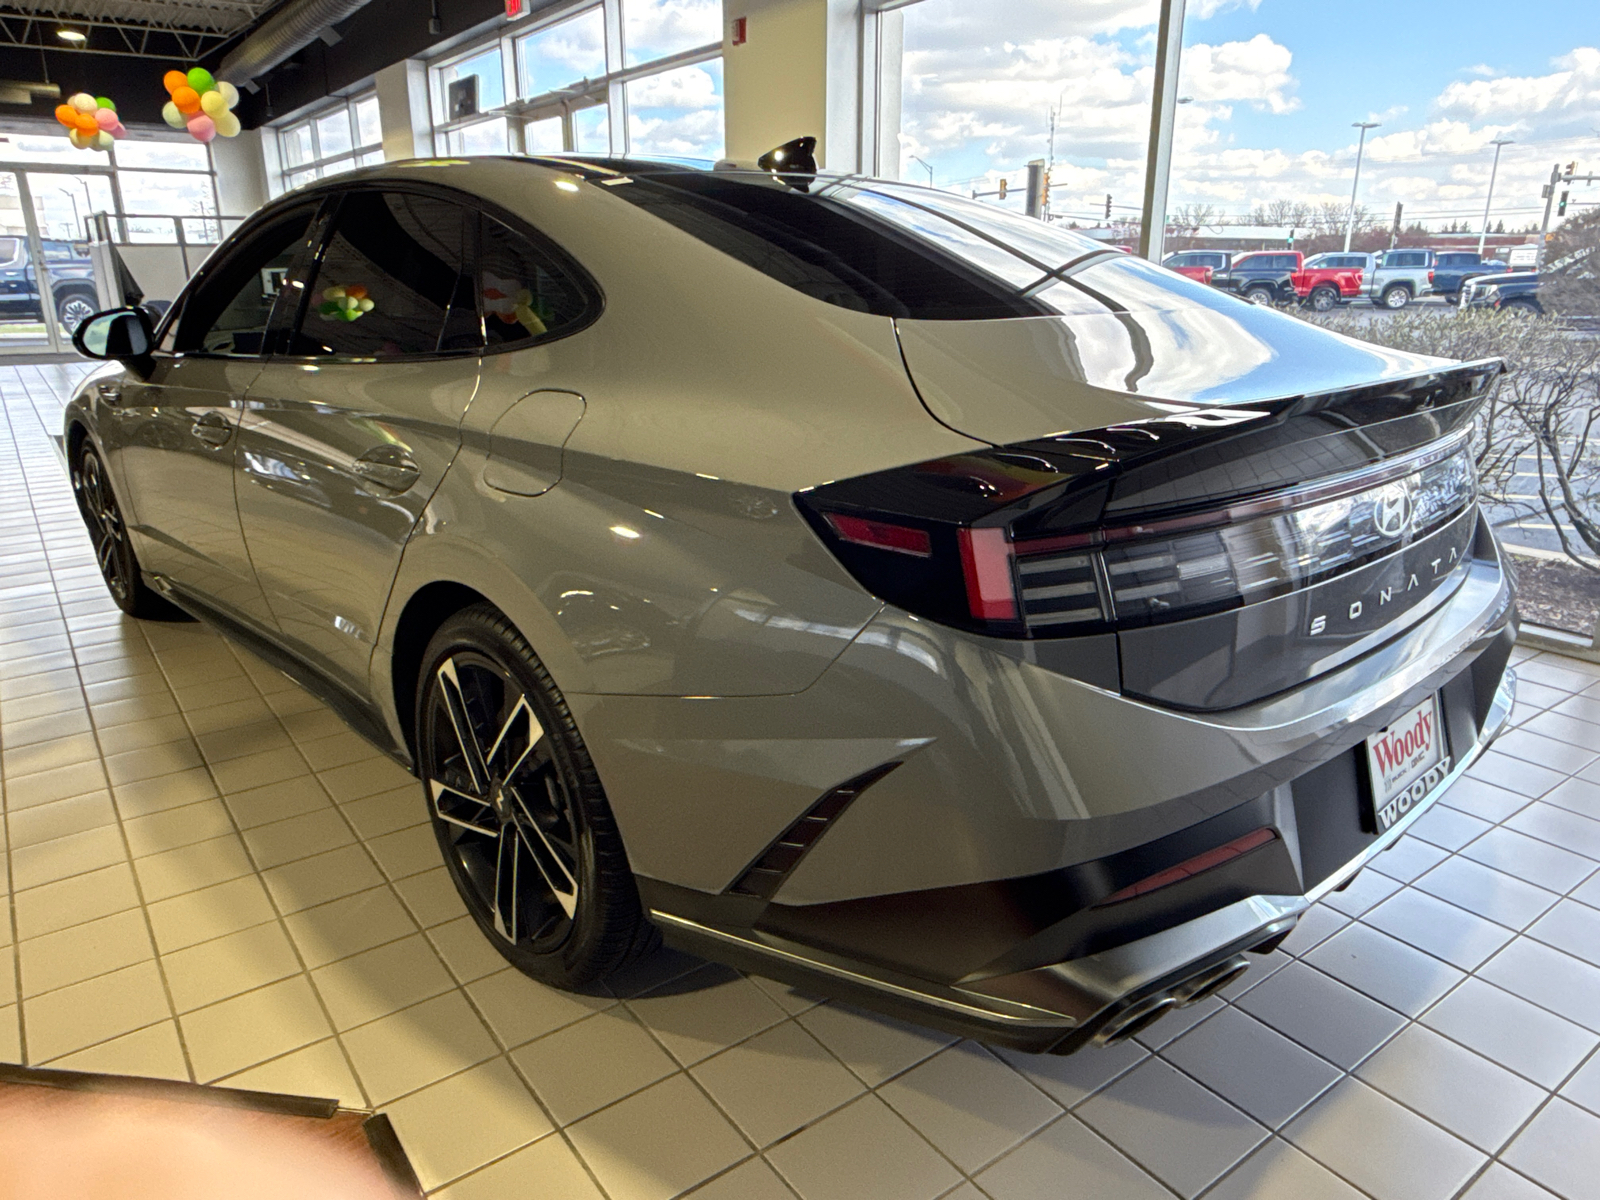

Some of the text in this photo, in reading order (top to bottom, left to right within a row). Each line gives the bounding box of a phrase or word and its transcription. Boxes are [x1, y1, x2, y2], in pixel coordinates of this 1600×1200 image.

[1310, 547, 1457, 636] SONATA
[1373, 710, 1432, 777] Woody
[1378, 756, 1451, 829] WOODY
